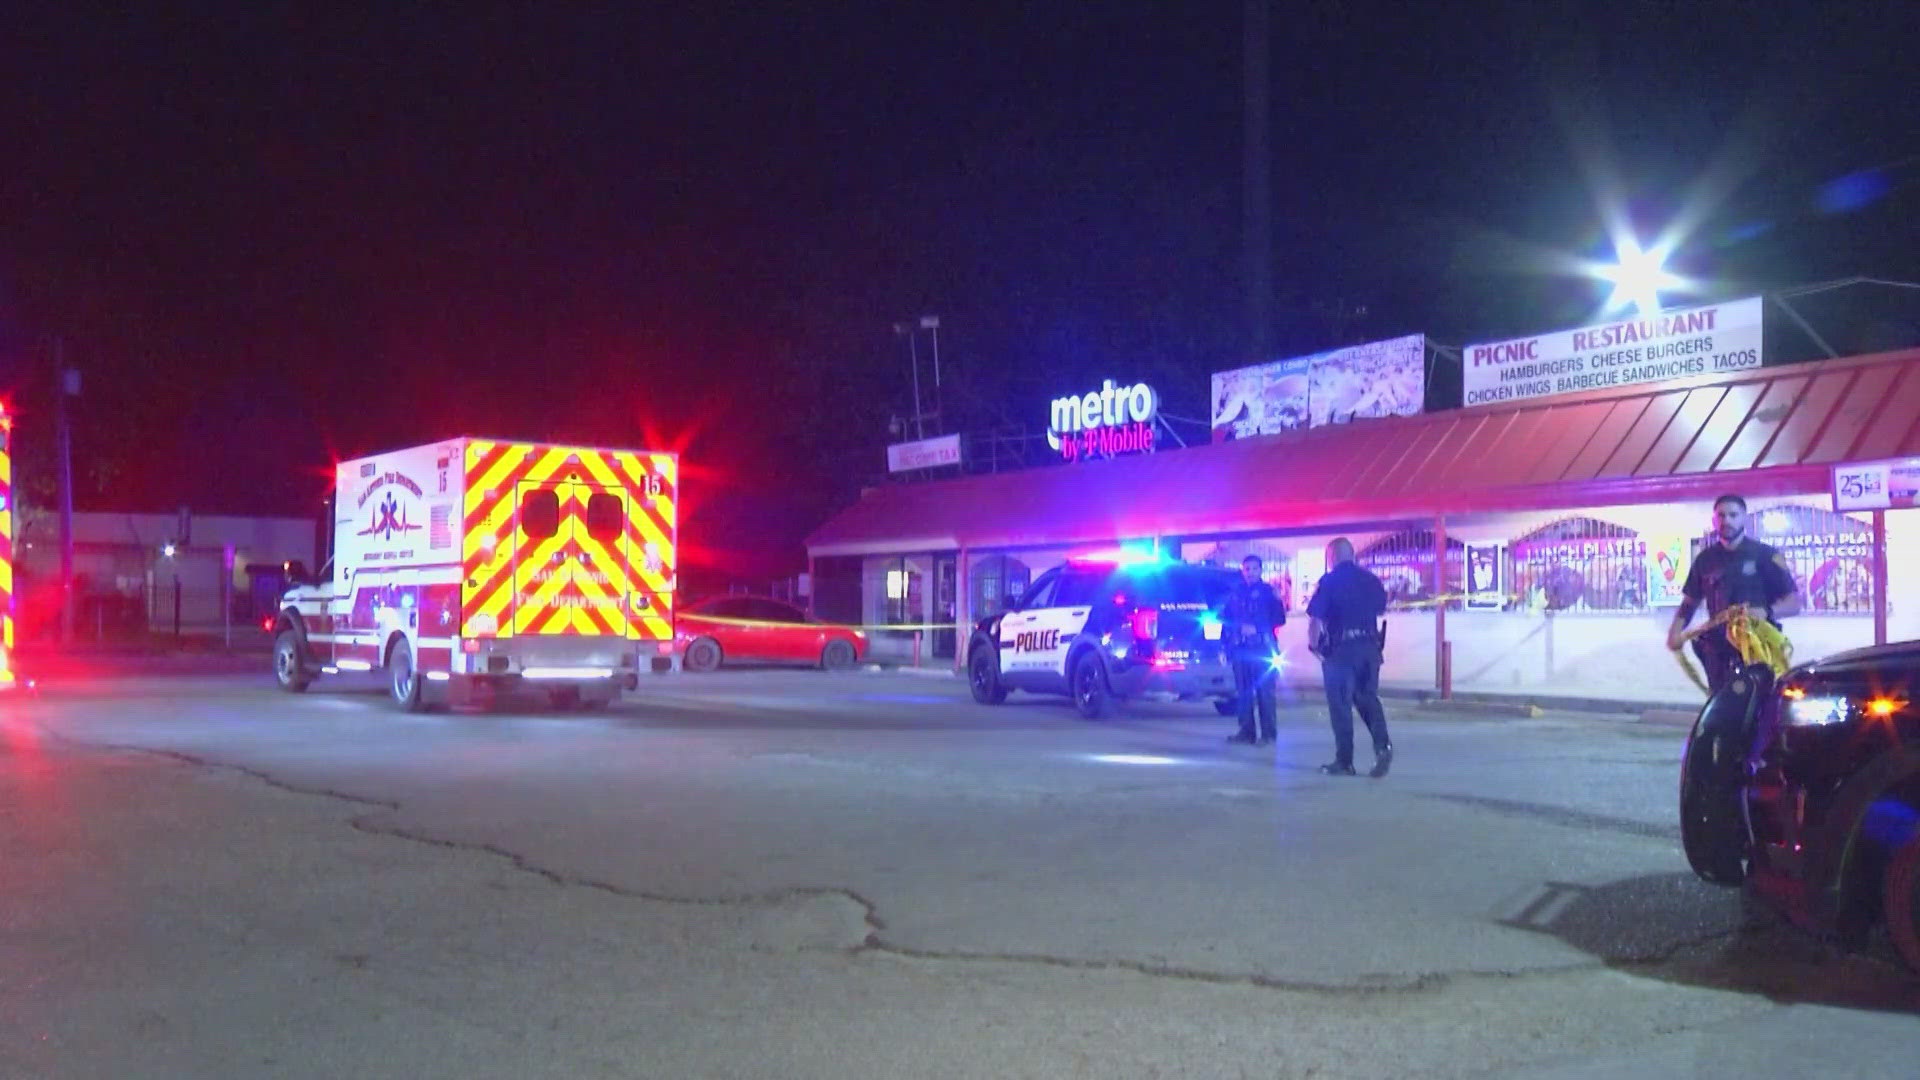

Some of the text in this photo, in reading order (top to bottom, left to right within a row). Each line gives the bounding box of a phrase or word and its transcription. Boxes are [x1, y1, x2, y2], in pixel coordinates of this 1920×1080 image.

[1473, 309, 1717, 367] PICNIC RESTAURANT
[1500, 338, 1713, 382] HAMBURGERS CHEESE BURGERS
[1467, 349, 1757, 404] CHICKEN WINGS BARBECUE SANDWICHES TACOS
[1050, 379, 1152, 433] metro
[1062, 434, 1079, 463] by
[643, 475, 661, 495] 15
[1016, 628, 1060, 653] POLICE
